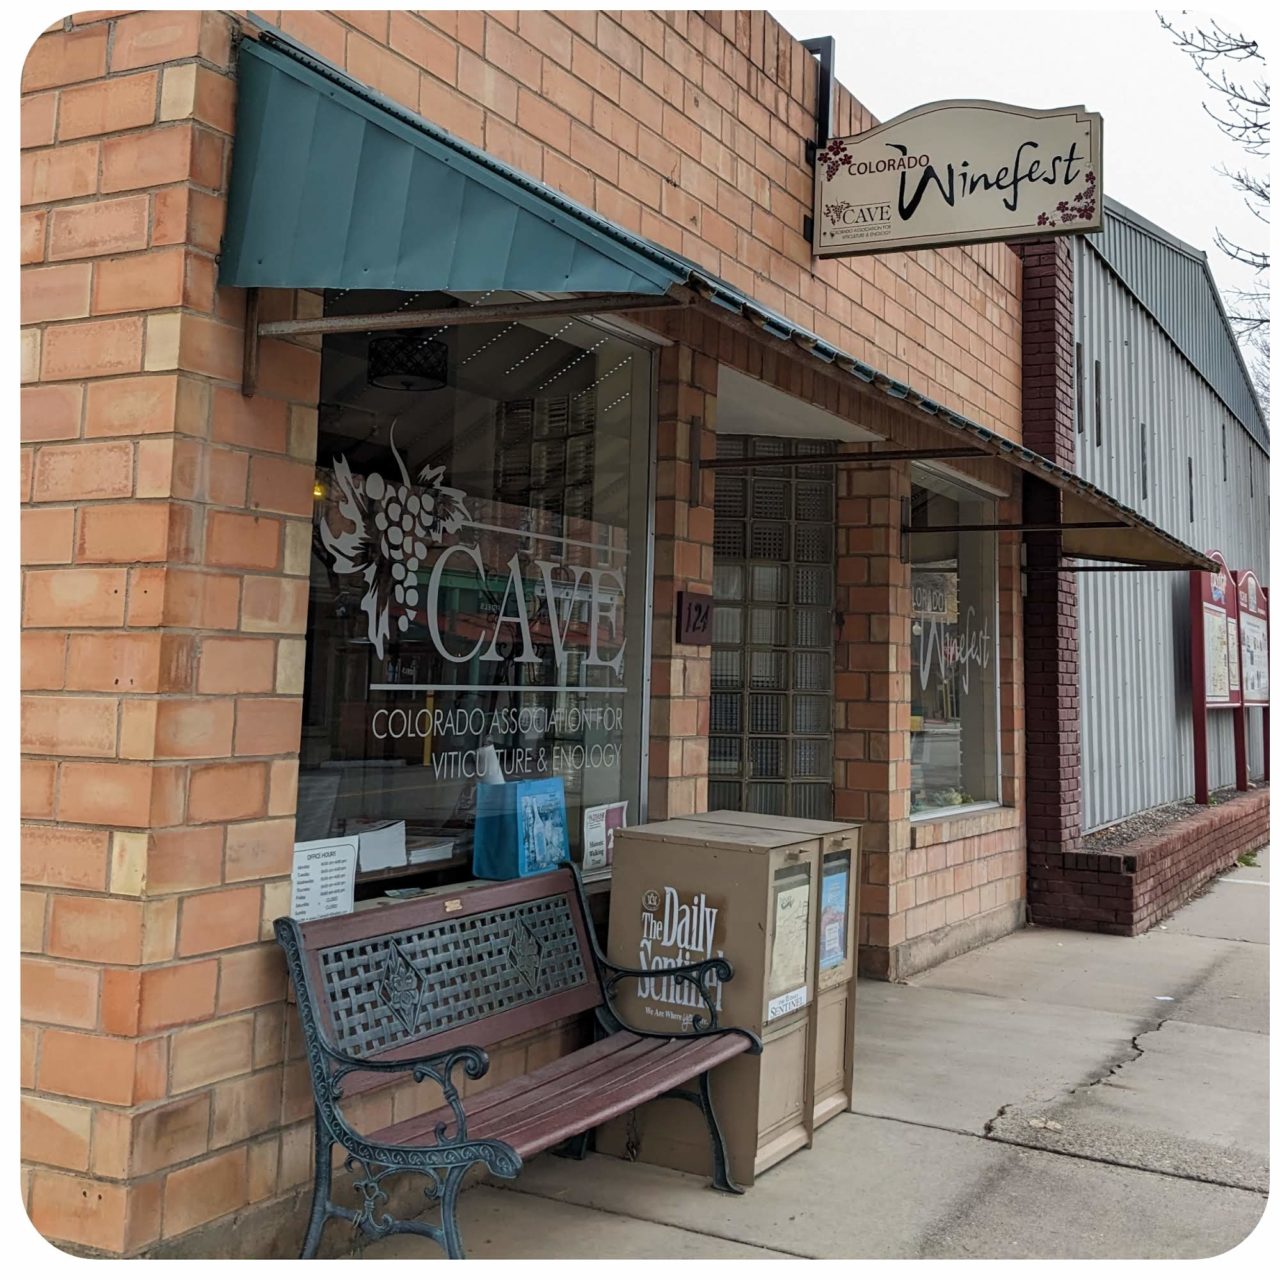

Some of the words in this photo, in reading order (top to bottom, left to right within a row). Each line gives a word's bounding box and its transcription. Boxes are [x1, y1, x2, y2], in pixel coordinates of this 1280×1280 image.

[848, 153, 930, 176] COLORADO
[885, 141, 1084, 221] Winefest
[842, 204, 892, 225] CAVE
[427, 543, 627, 676] CAVE
[685, 601, 710, 633] 124
[920, 605, 991, 696] Winefest
[372, 706, 485, 739] COLORADO
[489, 707, 593, 735] ASSOCIATION
[595, 706, 623, 730] FOR
[431, 747, 533, 781] VITICUTURE
[537, 747, 548, 772] &
[552, 742, 623, 772] ENOLOGY
[642, 912, 663, 940] The
[660, 886, 719, 961] Daily
